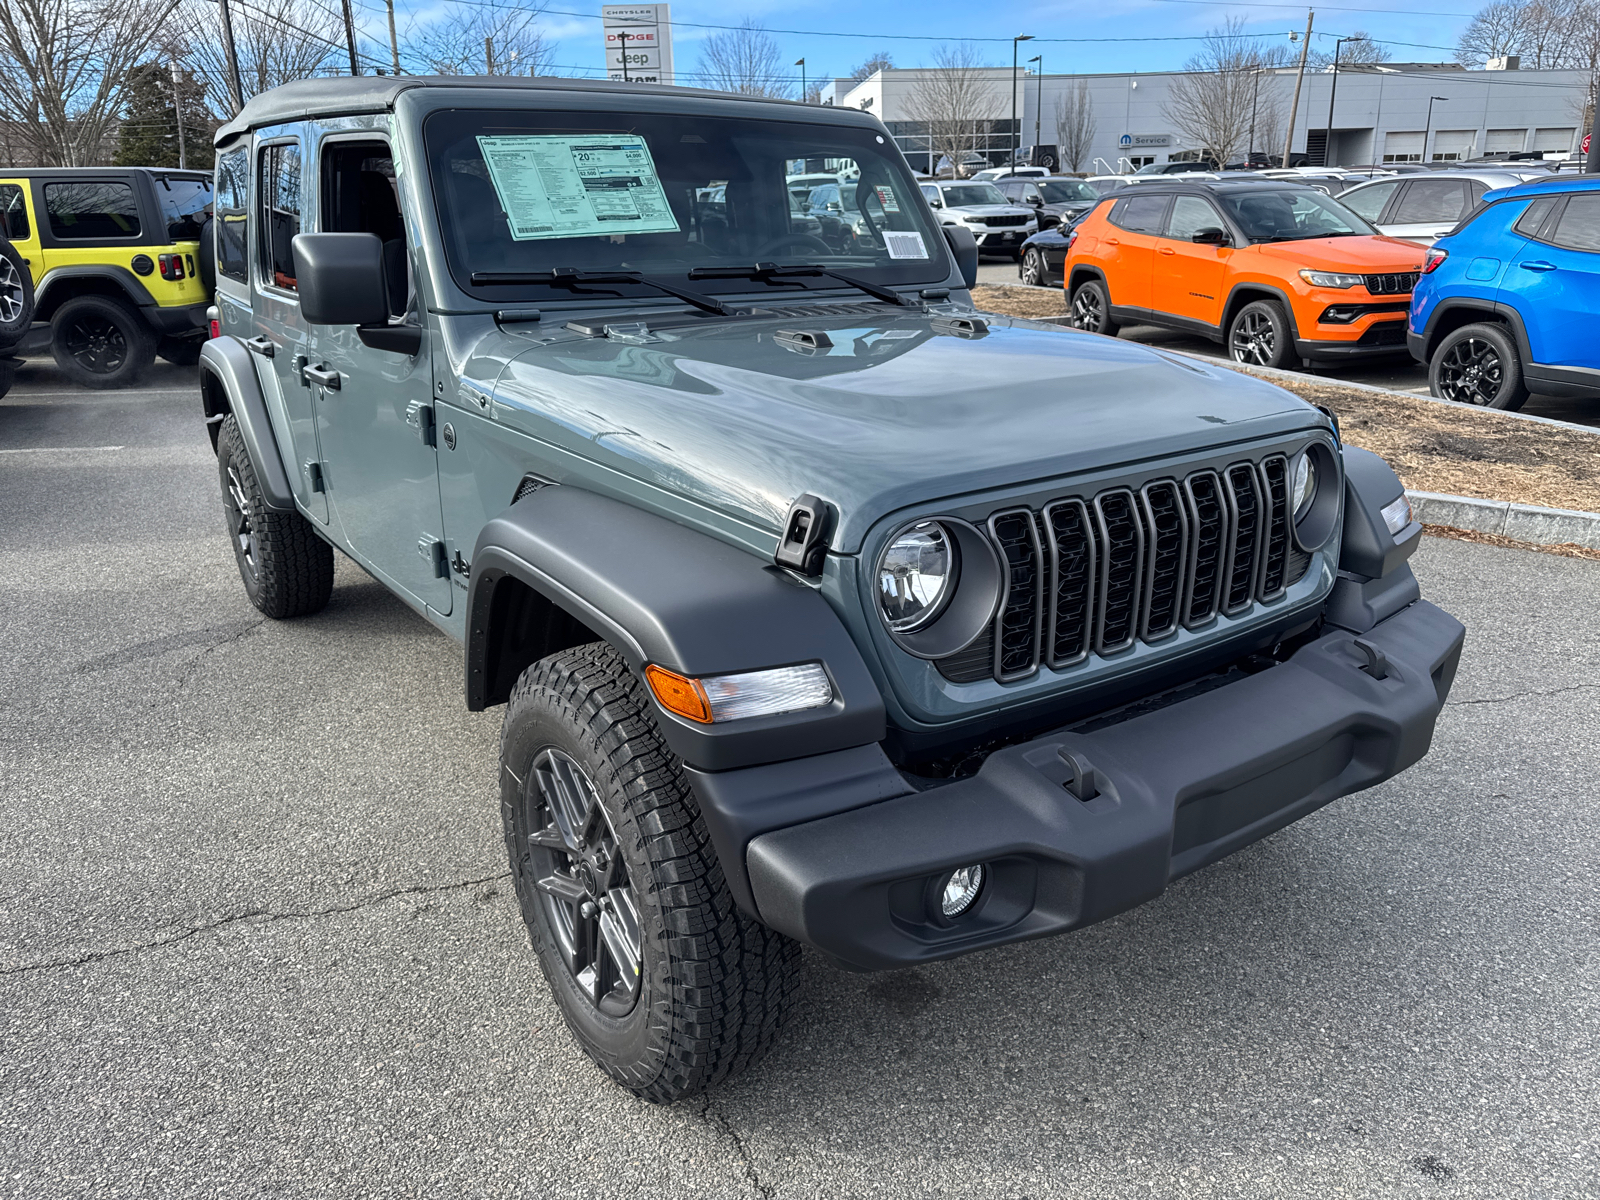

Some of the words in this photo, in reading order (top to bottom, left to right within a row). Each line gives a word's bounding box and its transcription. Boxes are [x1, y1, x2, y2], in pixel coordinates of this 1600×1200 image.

[616, 51, 649, 65] Jeep
[578, 153, 590, 161] 20
[451, 548, 471, 579] Je
